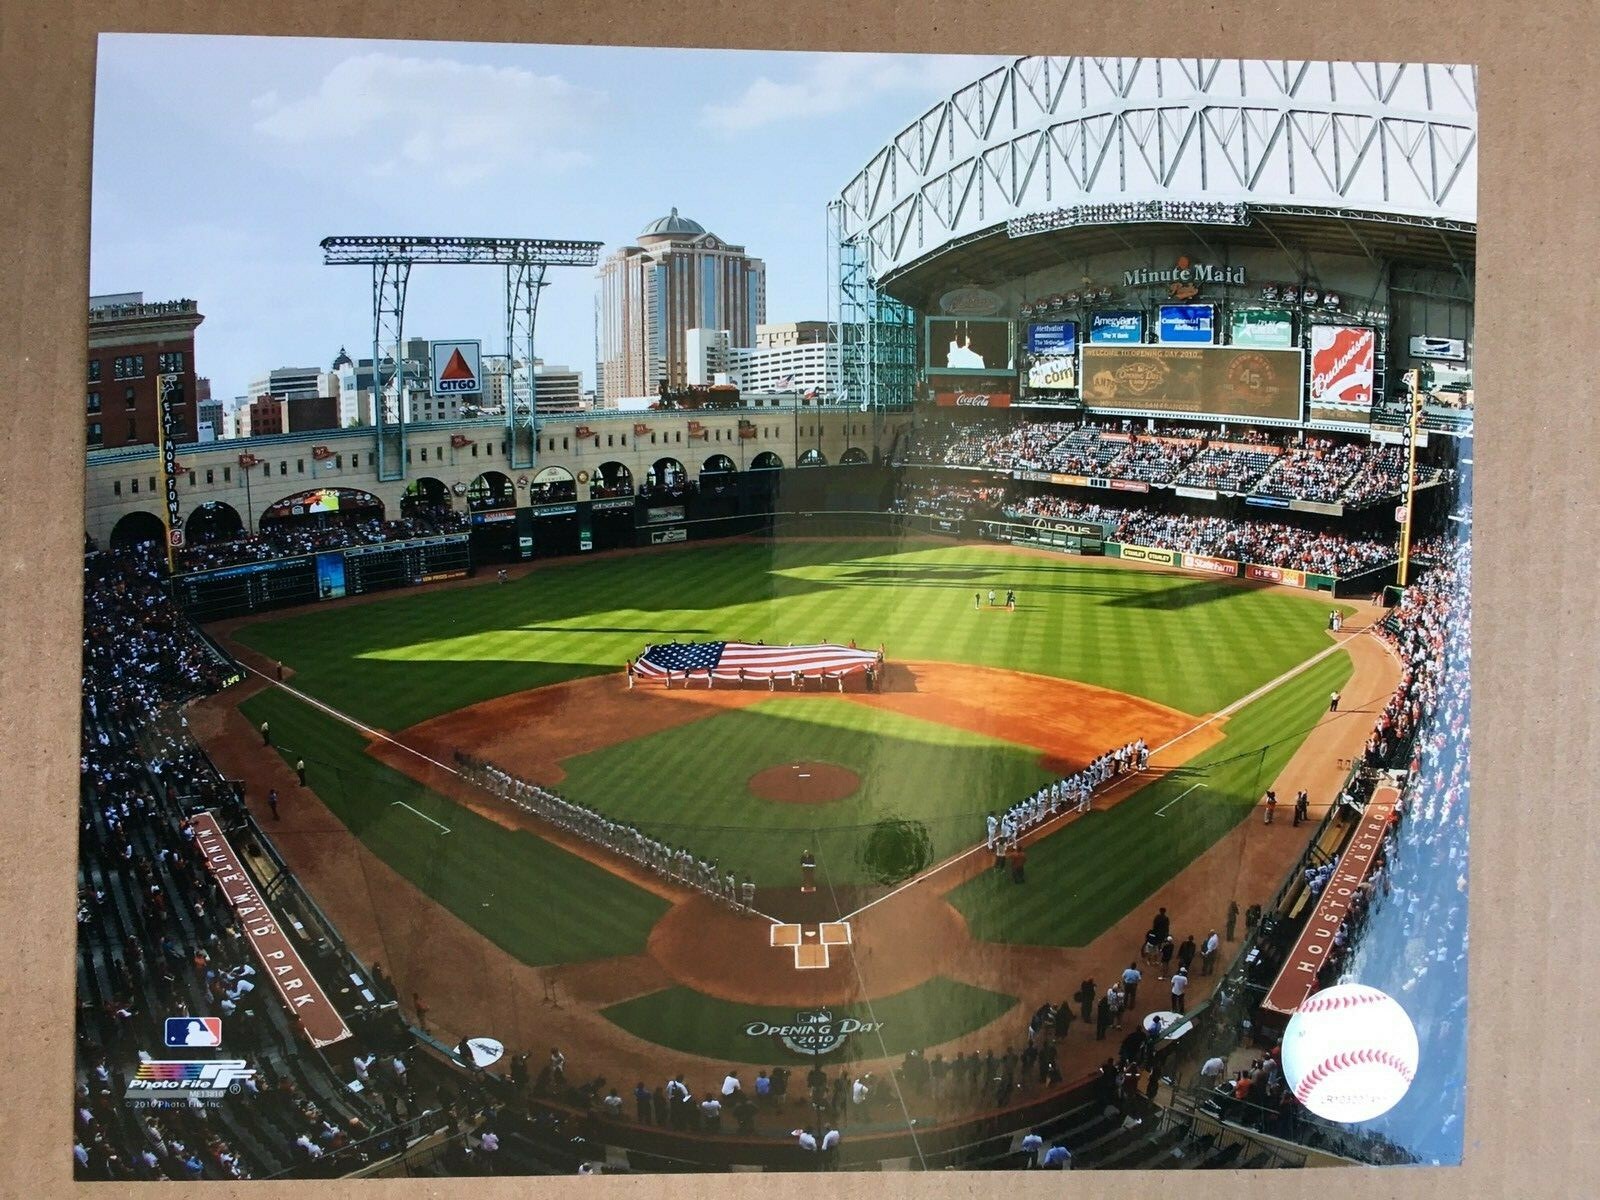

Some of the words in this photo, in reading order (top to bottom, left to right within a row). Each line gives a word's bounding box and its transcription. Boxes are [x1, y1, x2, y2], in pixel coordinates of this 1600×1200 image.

[1123, 266, 1190, 287] Minute
[1194, 264, 1246, 285] Maid
[1312, 328, 1373, 398] Budweiser
[439, 378, 476, 391] CITGO
[163, 402, 173, 432] EAT
[165, 441, 174, 473] MOR
[168, 479, 179, 524] FOWL
[1048, 523, 1091, 534] LEXUS
[1297, 874, 1358, 973] HOUSTON
[1354, 804, 1389, 863] ASTROS
[198, 828, 238, 883] MINUTE
[233, 892, 270, 937] MAID
[266, 949, 315, 1008] PARK
[127, 1079, 179, 1089] Photo
[180, 1079, 211, 1089] File
[159, 1100, 186, 1108] Photo
[206, 1100, 224, 1108] Inc.
